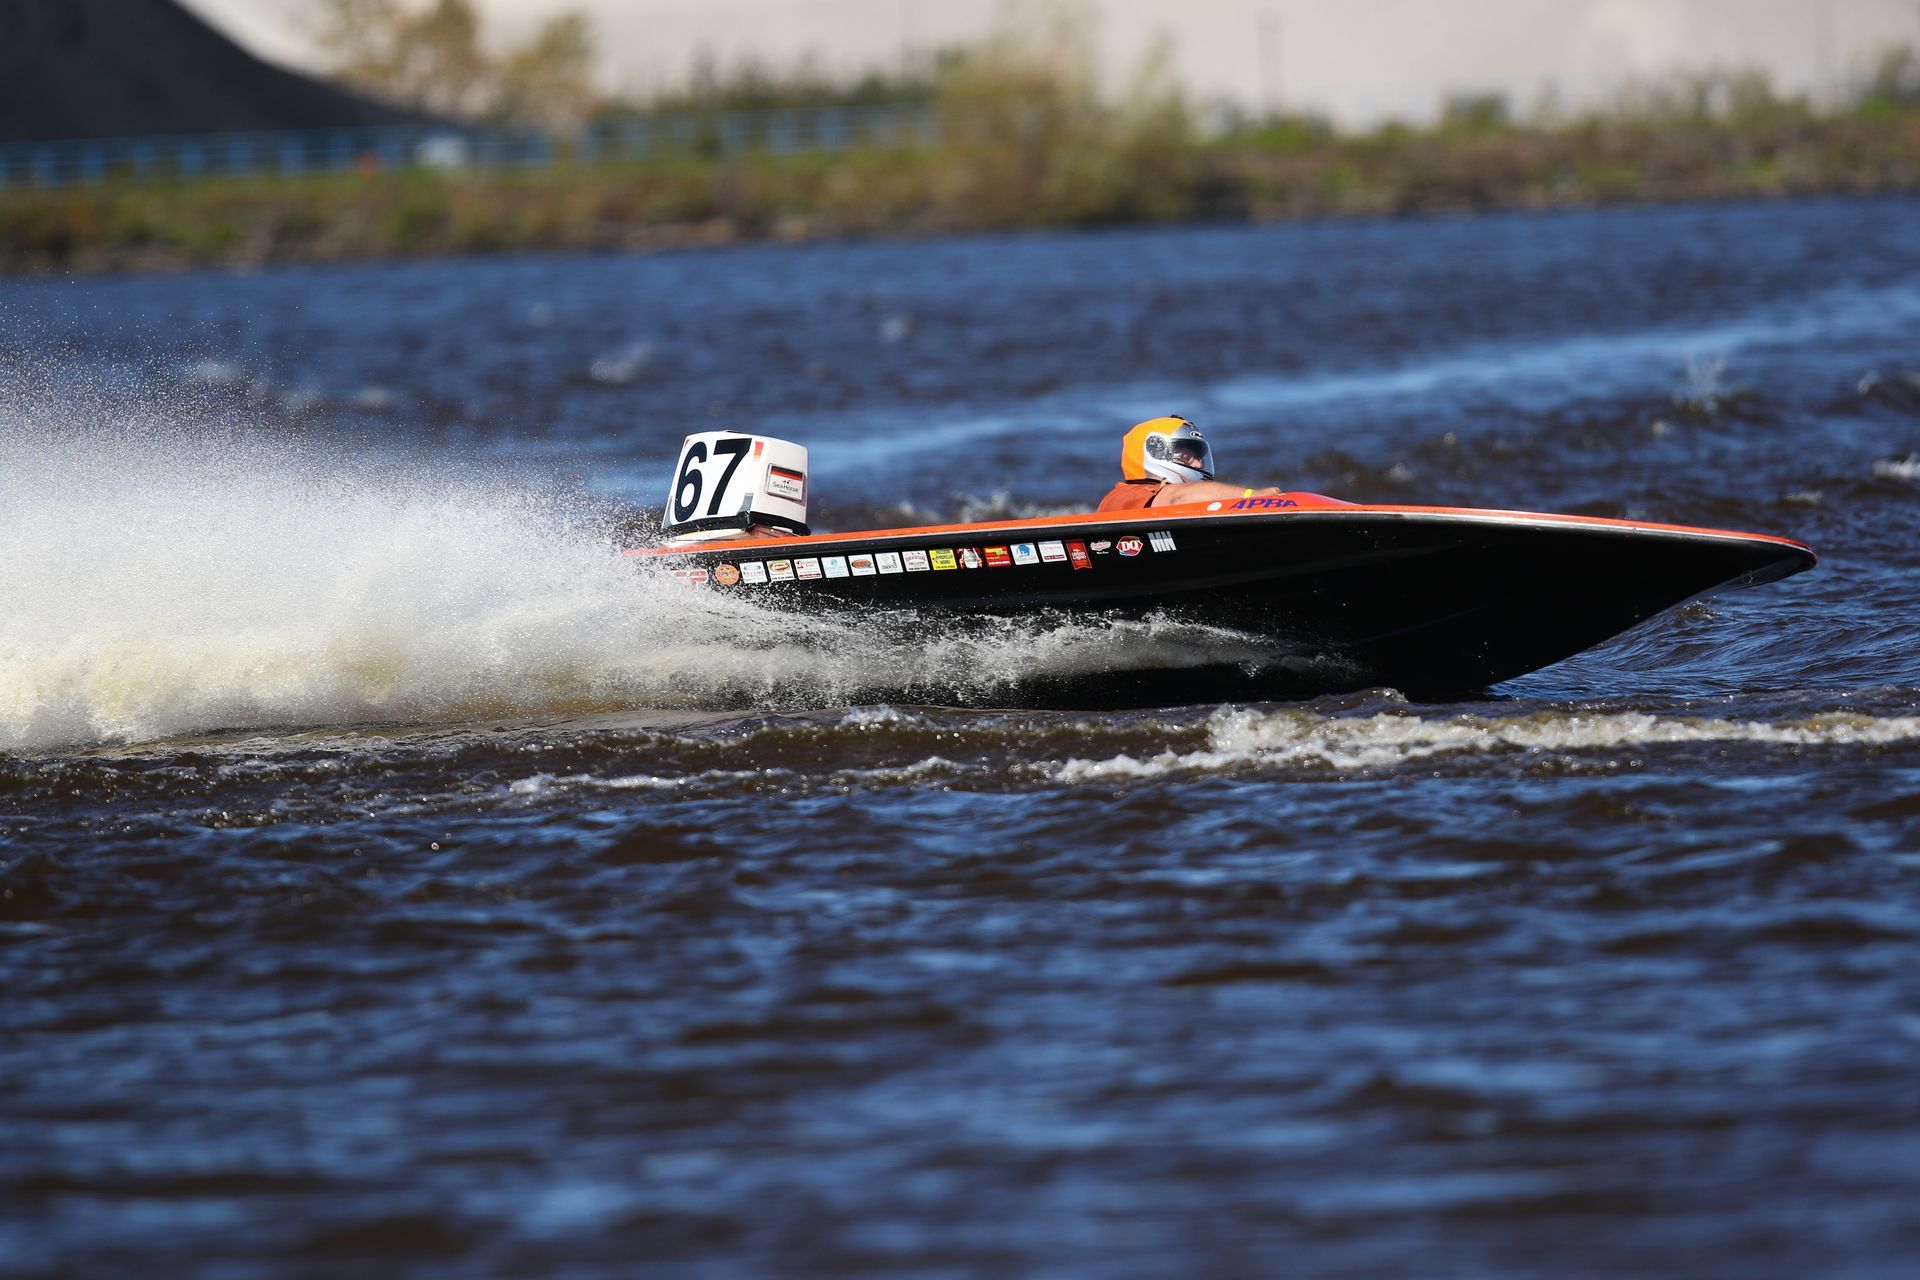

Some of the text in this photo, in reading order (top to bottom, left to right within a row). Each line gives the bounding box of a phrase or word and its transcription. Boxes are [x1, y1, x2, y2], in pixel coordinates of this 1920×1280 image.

[674, 438, 752, 522] 67
[1230, 498, 1298, 509] APRA
[1120, 540, 1139, 551] DQ
